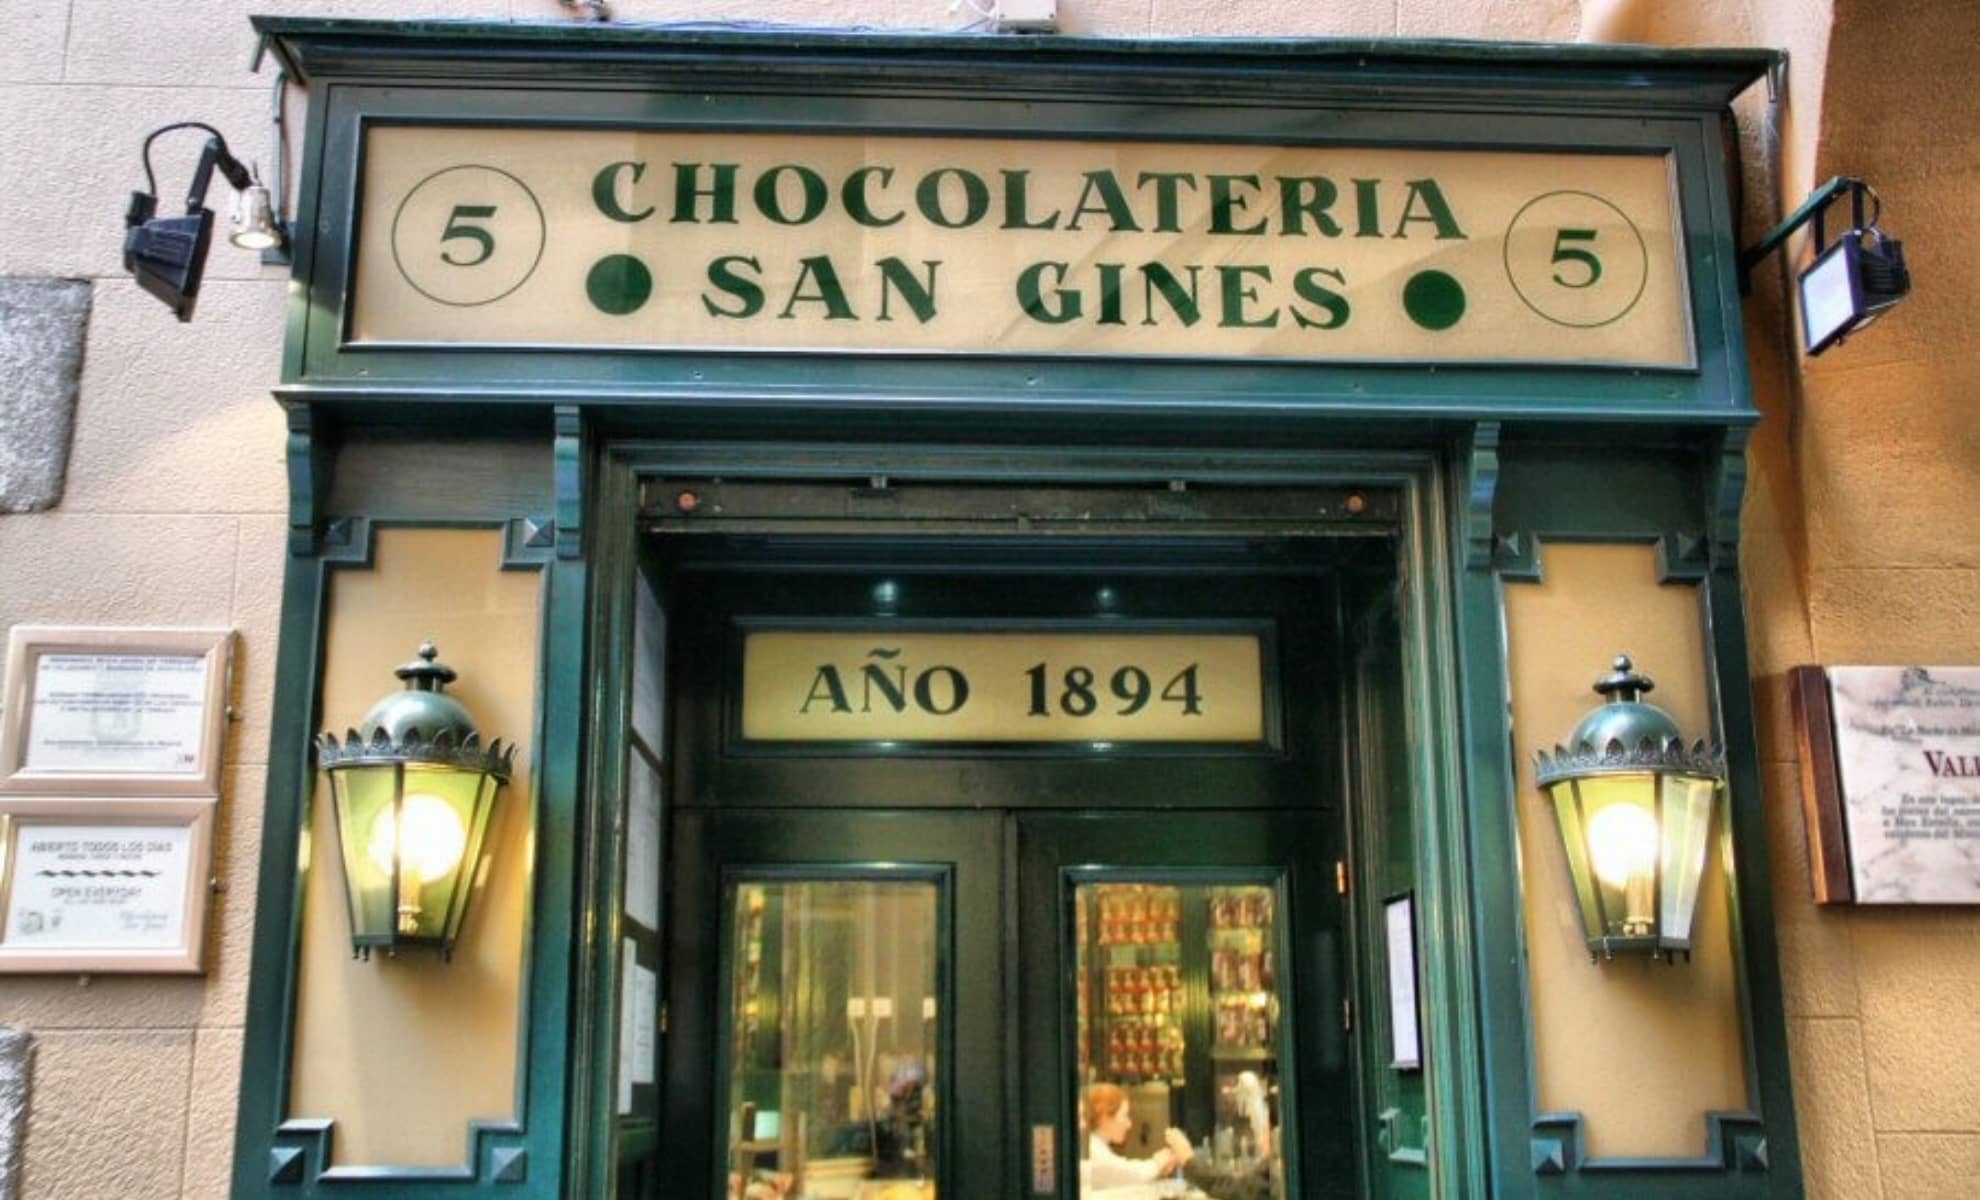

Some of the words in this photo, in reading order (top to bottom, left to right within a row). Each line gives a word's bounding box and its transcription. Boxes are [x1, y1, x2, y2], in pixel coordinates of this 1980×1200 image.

[592, 161, 1467, 239] CHOCOLATERIA
[440, 205, 497, 266] 5
[1551, 228, 1602, 288] 5
[701, 254, 943, 324] SAN
[1016, 261, 1351, 330] GINES
[800, 648, 970, 716] AÑO
[1024, 662, 1203, 717] 1894
